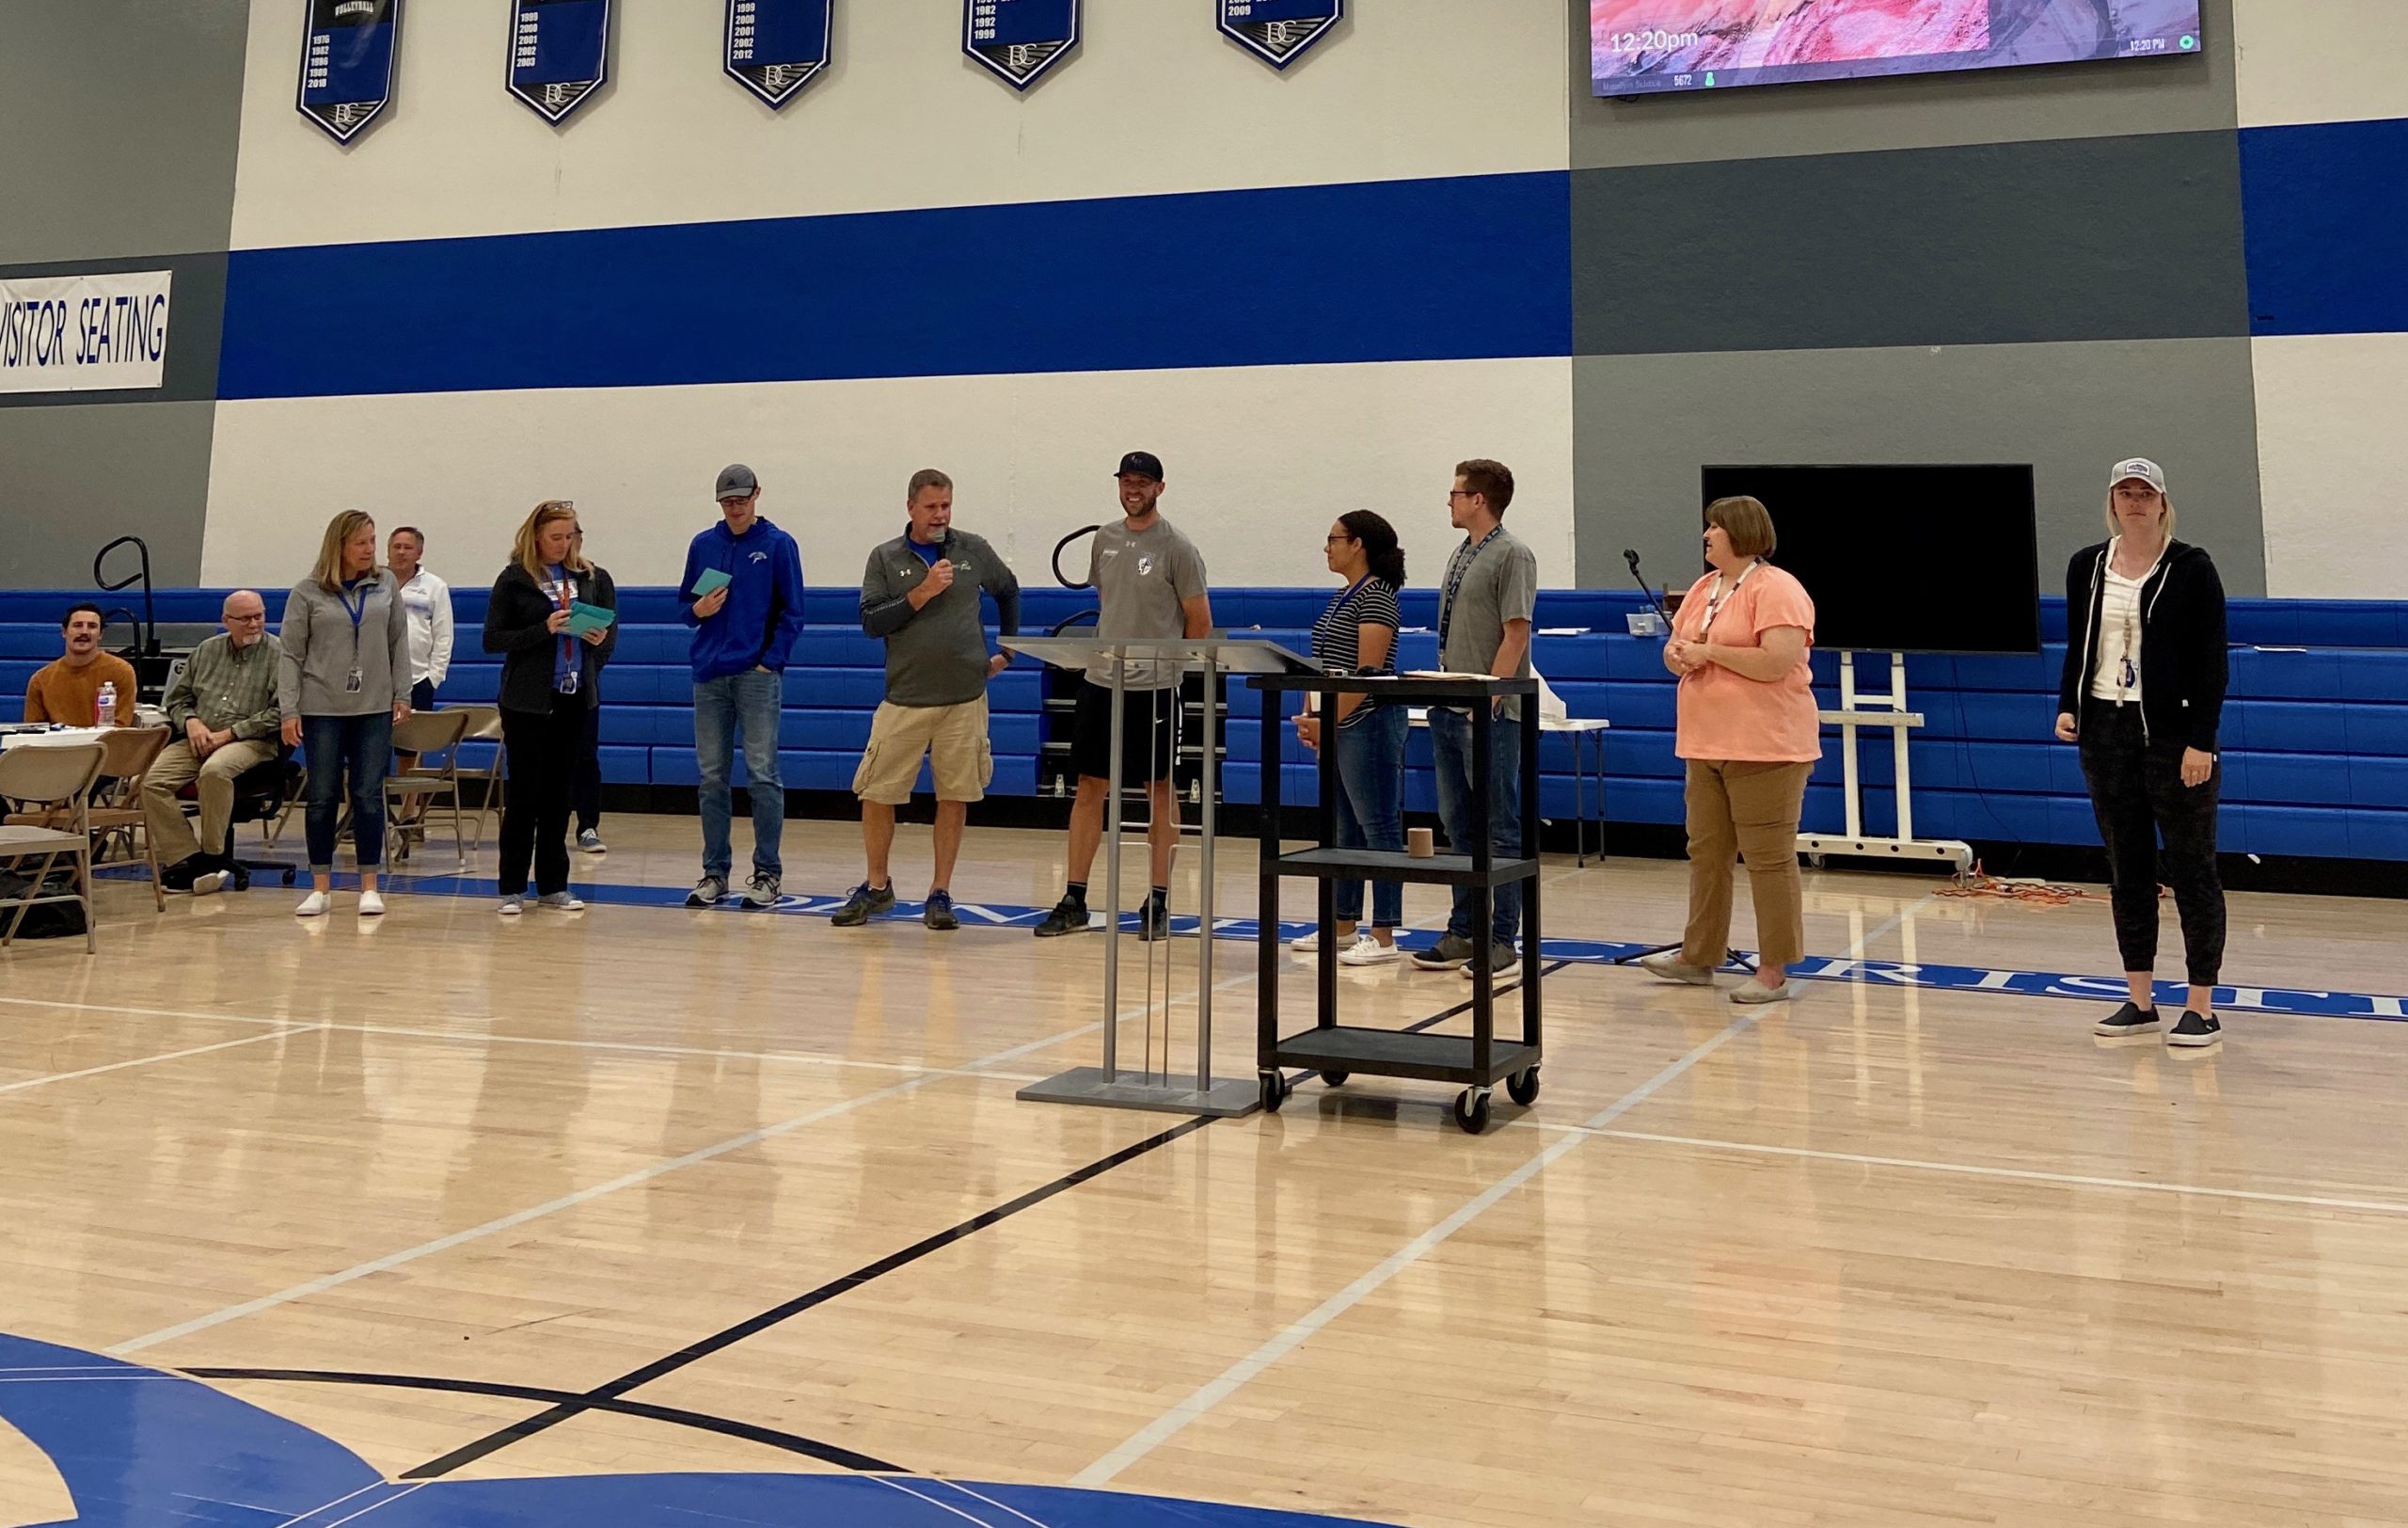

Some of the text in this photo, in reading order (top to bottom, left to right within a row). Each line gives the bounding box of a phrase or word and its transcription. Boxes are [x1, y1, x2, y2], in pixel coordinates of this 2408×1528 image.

[335, 1, 373, 16] VOLLEYBALL
[737, 3, 755, 13] 1999
[974, 5, 996, 16] 1982
[1228, 5, 1251, 16] 2009
[735, 14, 755, 24] 2000
[974, 16, 996, 27] 1992
[734, 26, 754, 37] 2001
[974, 28, 996, 40] 1999
[518, 35, 538, 45] 2001
[733, 38, 753, 48] 2002
[1610, 29, 1699, 54] 12:20pm
[2130, 38, 2165, 52] 12:20 PM
[517, 46, 537, 56] 2002
[732, 49, 753, 59] 2012
[1673, 74, 1692, 87] 5672
[76, 294, 166, 365] SEATING
